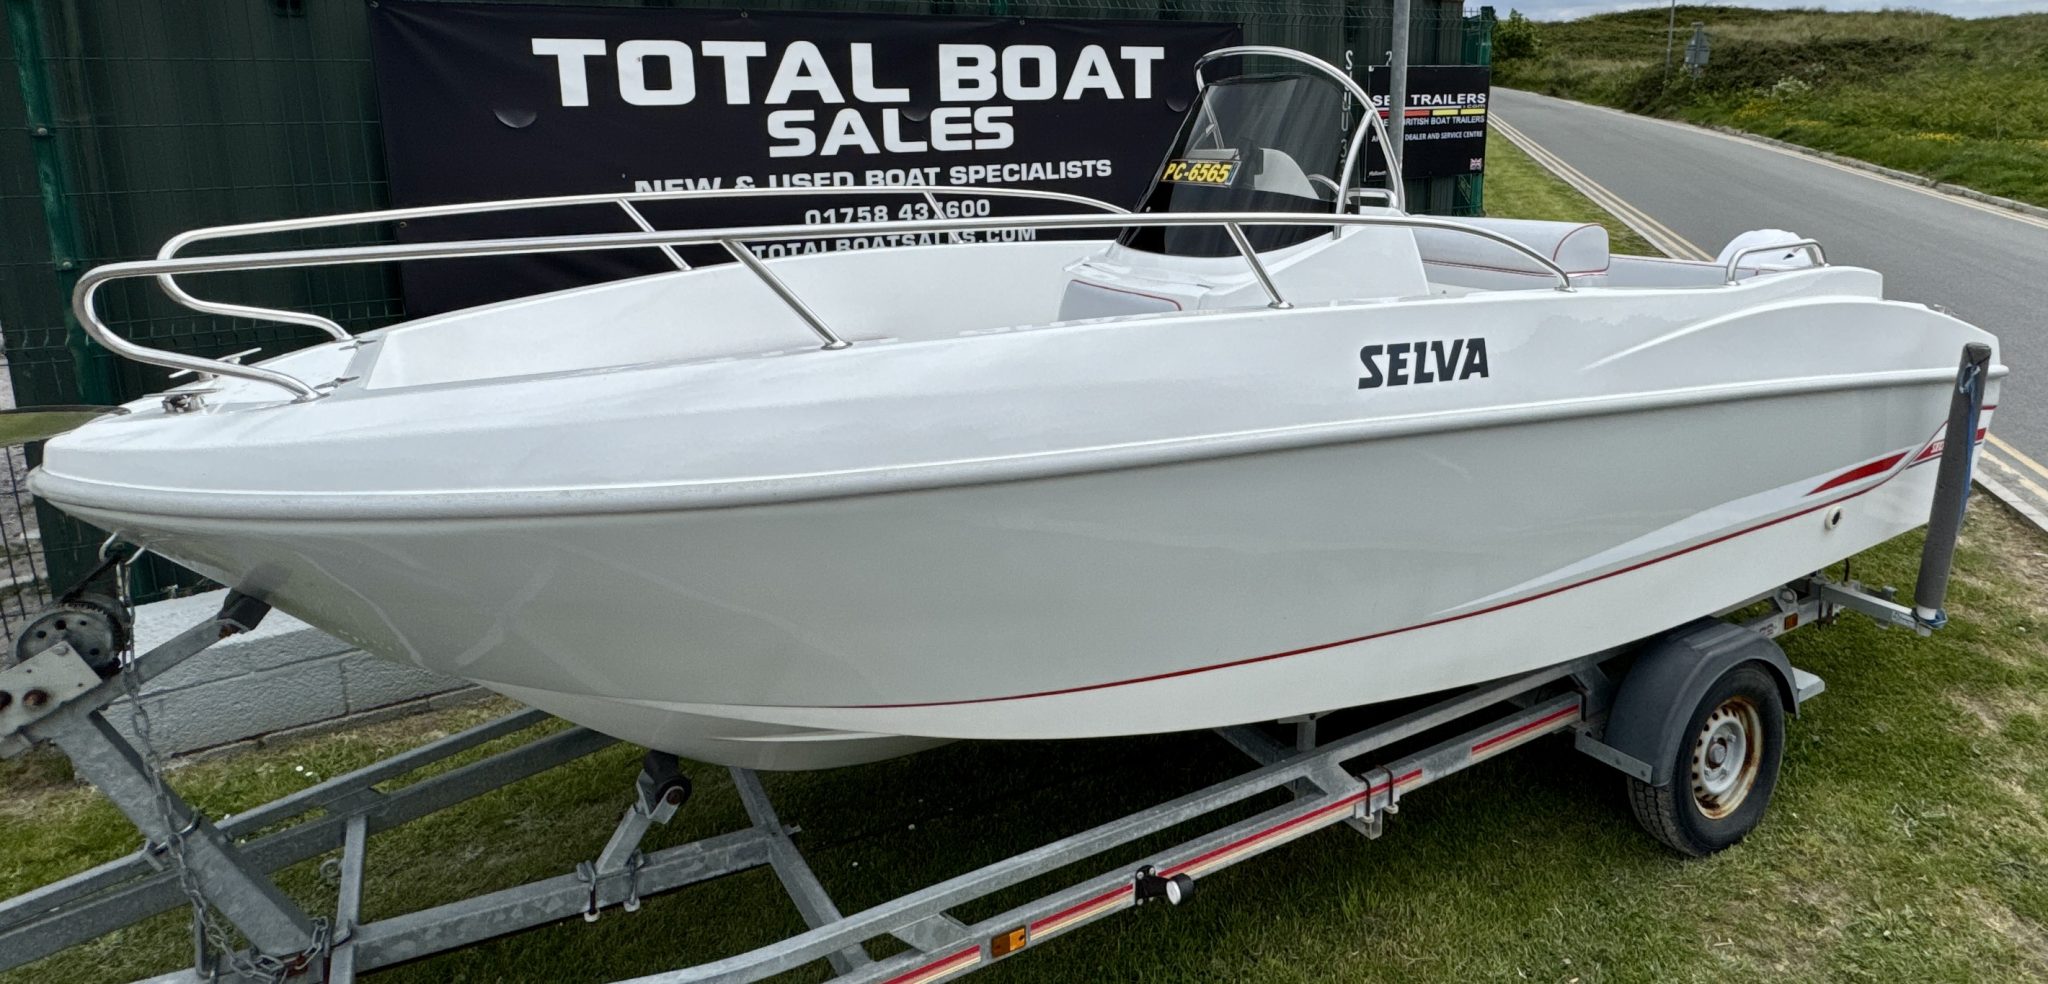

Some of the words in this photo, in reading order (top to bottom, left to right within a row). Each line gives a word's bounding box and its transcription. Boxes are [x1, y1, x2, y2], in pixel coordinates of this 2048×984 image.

[531, 38, 910, 108] TOTAL
[938, 42, 1166, 102] BOAT
[1411, 94, 1486, 105] TRAILERS
[767, 106, 1015, 159] SALES
[1431, 116, 1450, 125] BOAT
[1452, 115, 1485, 124] TRAILERS
[1405, 132, 1426, 141] DEALER
[1427, 132, 1440, 140] AND
[635, 177, 722, 193] NEW
[734, 175, 756, 189] &
[768, 170, 857, 189] USED
[865, 167, 941, 187] BOAT
[949, 160, 1112, 183] SPECIALISTS
[1163, 163, 1232, 183] PC-6565
[805, 206, 889, 225] 01758
[751, 228, 1037, 260] TOTALBOATSALS.COM
[1358, 337, 1490, 390] SELVA
